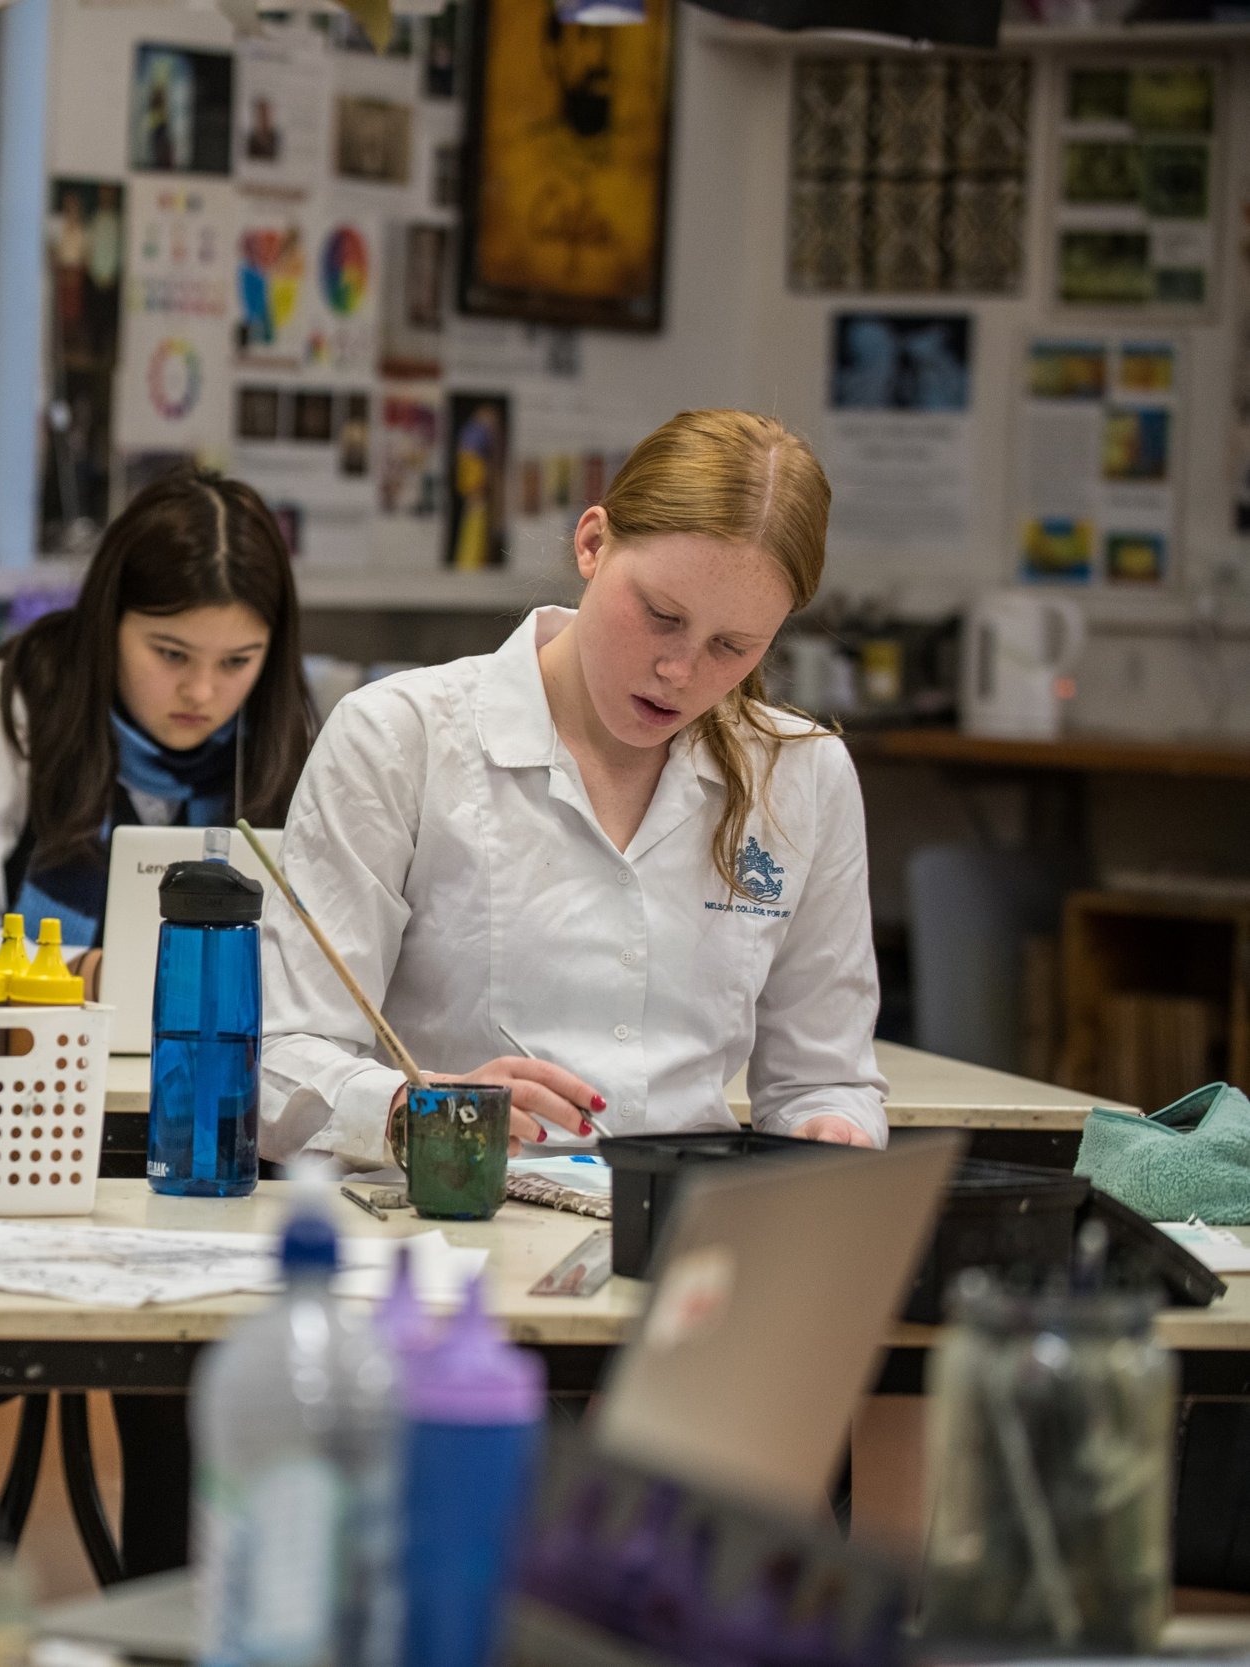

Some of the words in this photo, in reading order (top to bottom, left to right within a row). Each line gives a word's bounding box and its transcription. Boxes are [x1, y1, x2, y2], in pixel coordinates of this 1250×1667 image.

[704, 901, 734, 913] NELSON
[735, 905, 766, 917] COLLEGE
[767, 909, 781, 918] FOR
